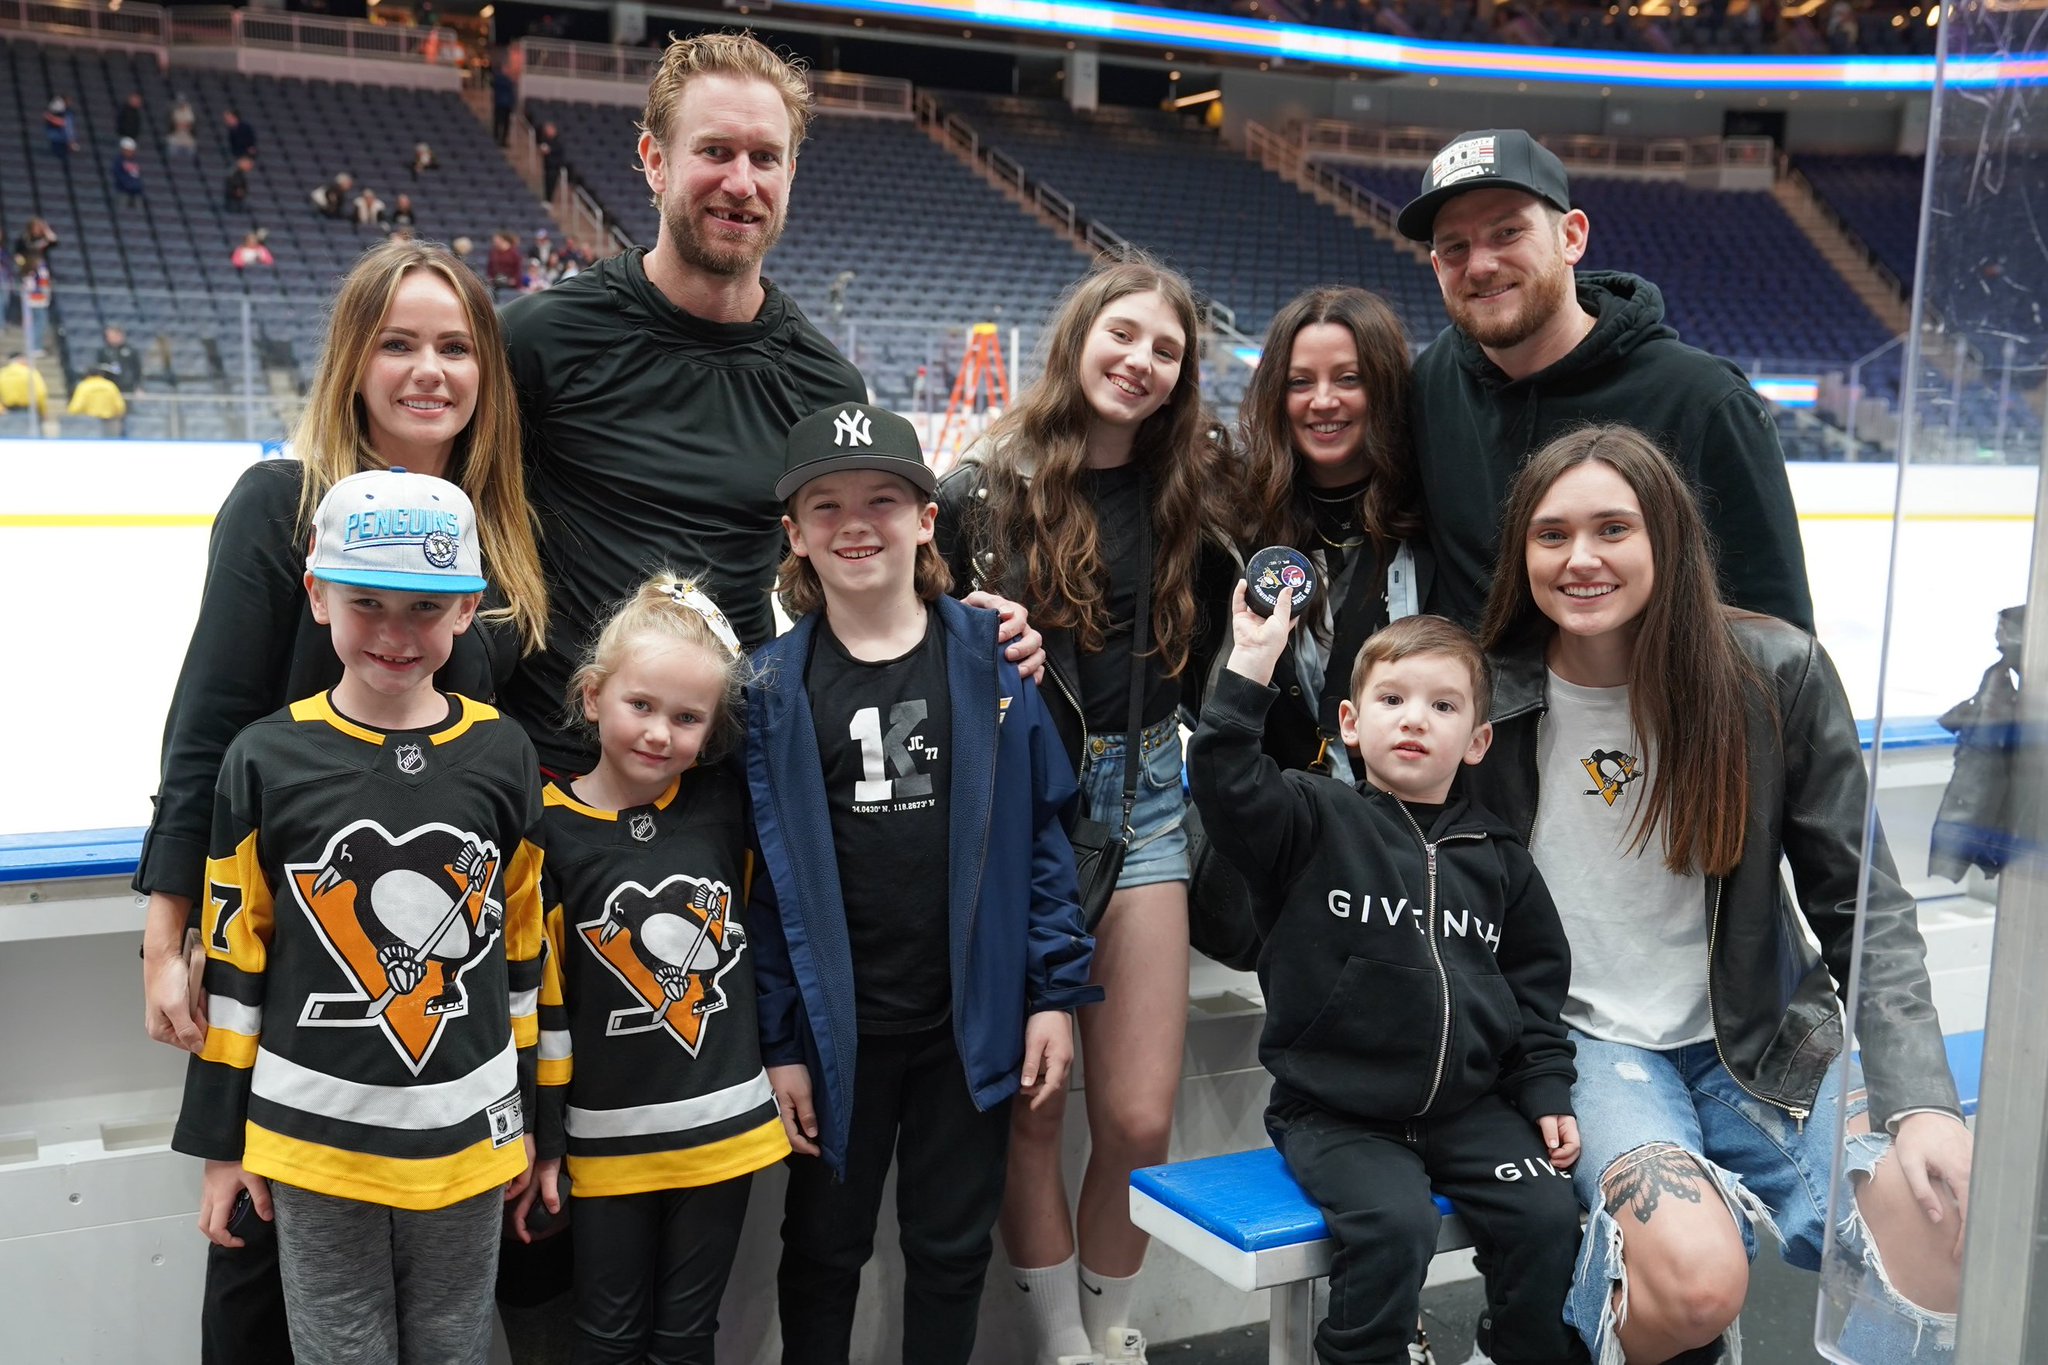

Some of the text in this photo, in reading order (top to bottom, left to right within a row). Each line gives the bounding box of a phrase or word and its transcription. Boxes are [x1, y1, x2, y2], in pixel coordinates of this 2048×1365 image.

[833, 409, 873, 447] NY
[344, 508, 460, 542] PENGUINS
[1254, 584, 1277, 606] TSBURGH
[907, 735, 924, 751] JC
[925, 747, 938, 760] 77
[403, 752, 418, 769] NHL
[209, 879, 243, 954] 7
